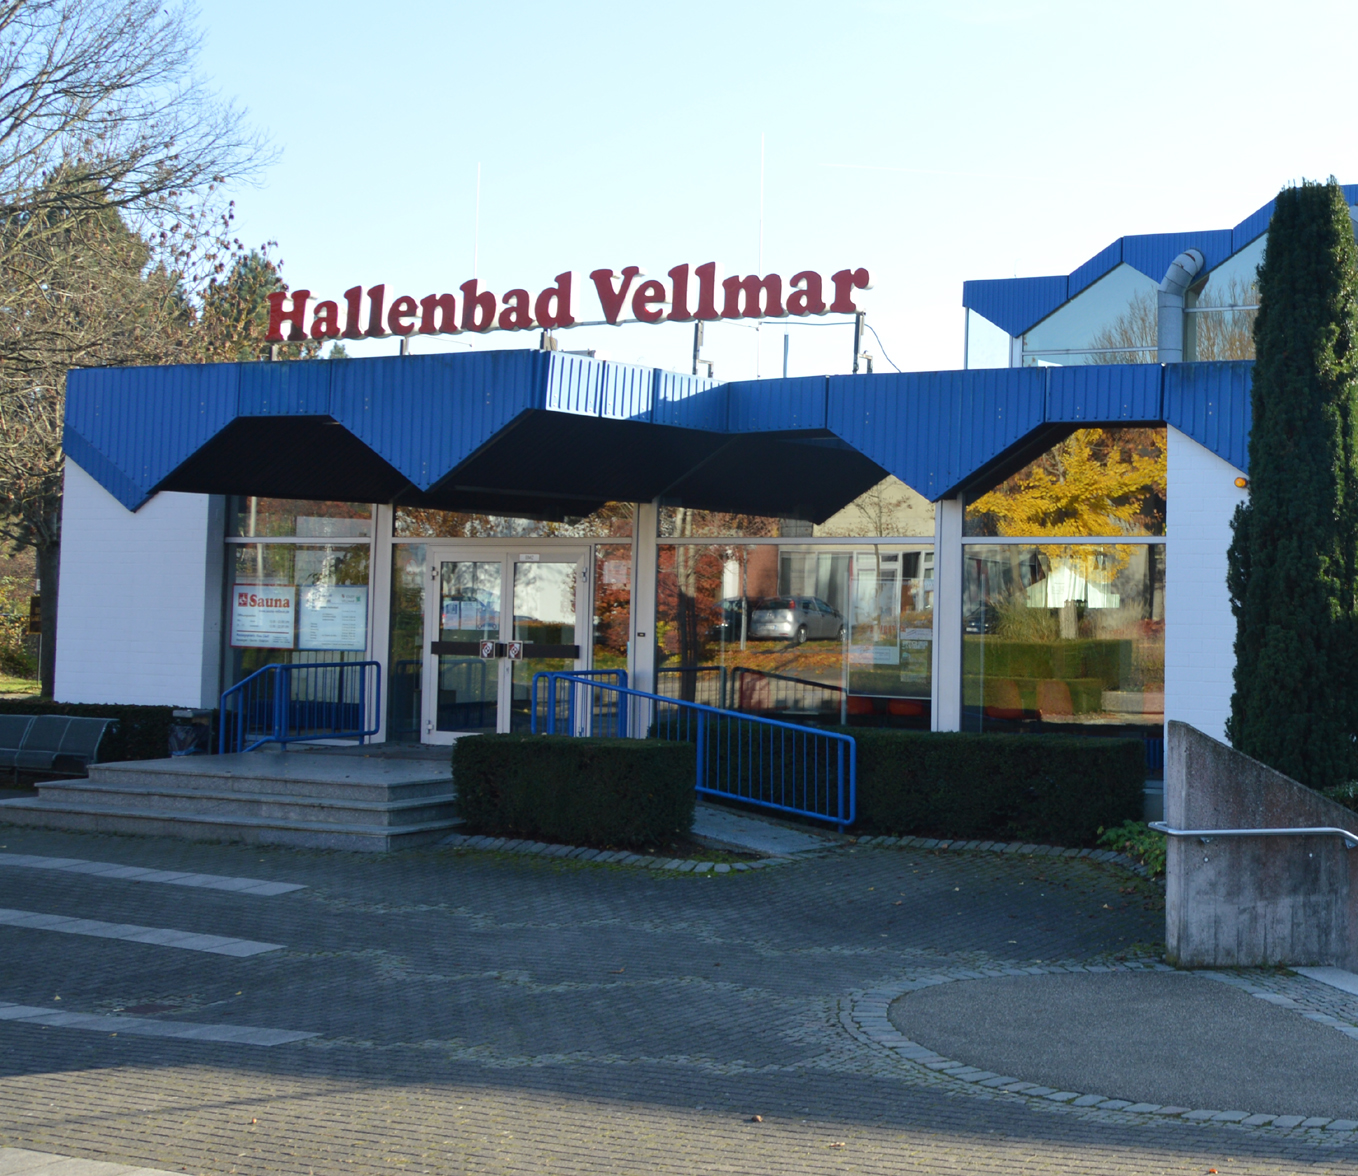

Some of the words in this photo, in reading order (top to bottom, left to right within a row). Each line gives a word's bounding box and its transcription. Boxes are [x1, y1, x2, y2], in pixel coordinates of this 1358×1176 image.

[265, 271, 576, 342] Hallenbad
[589, 261, 872, 325] Vellmar
[249, 594, 290, 608] Sauna
